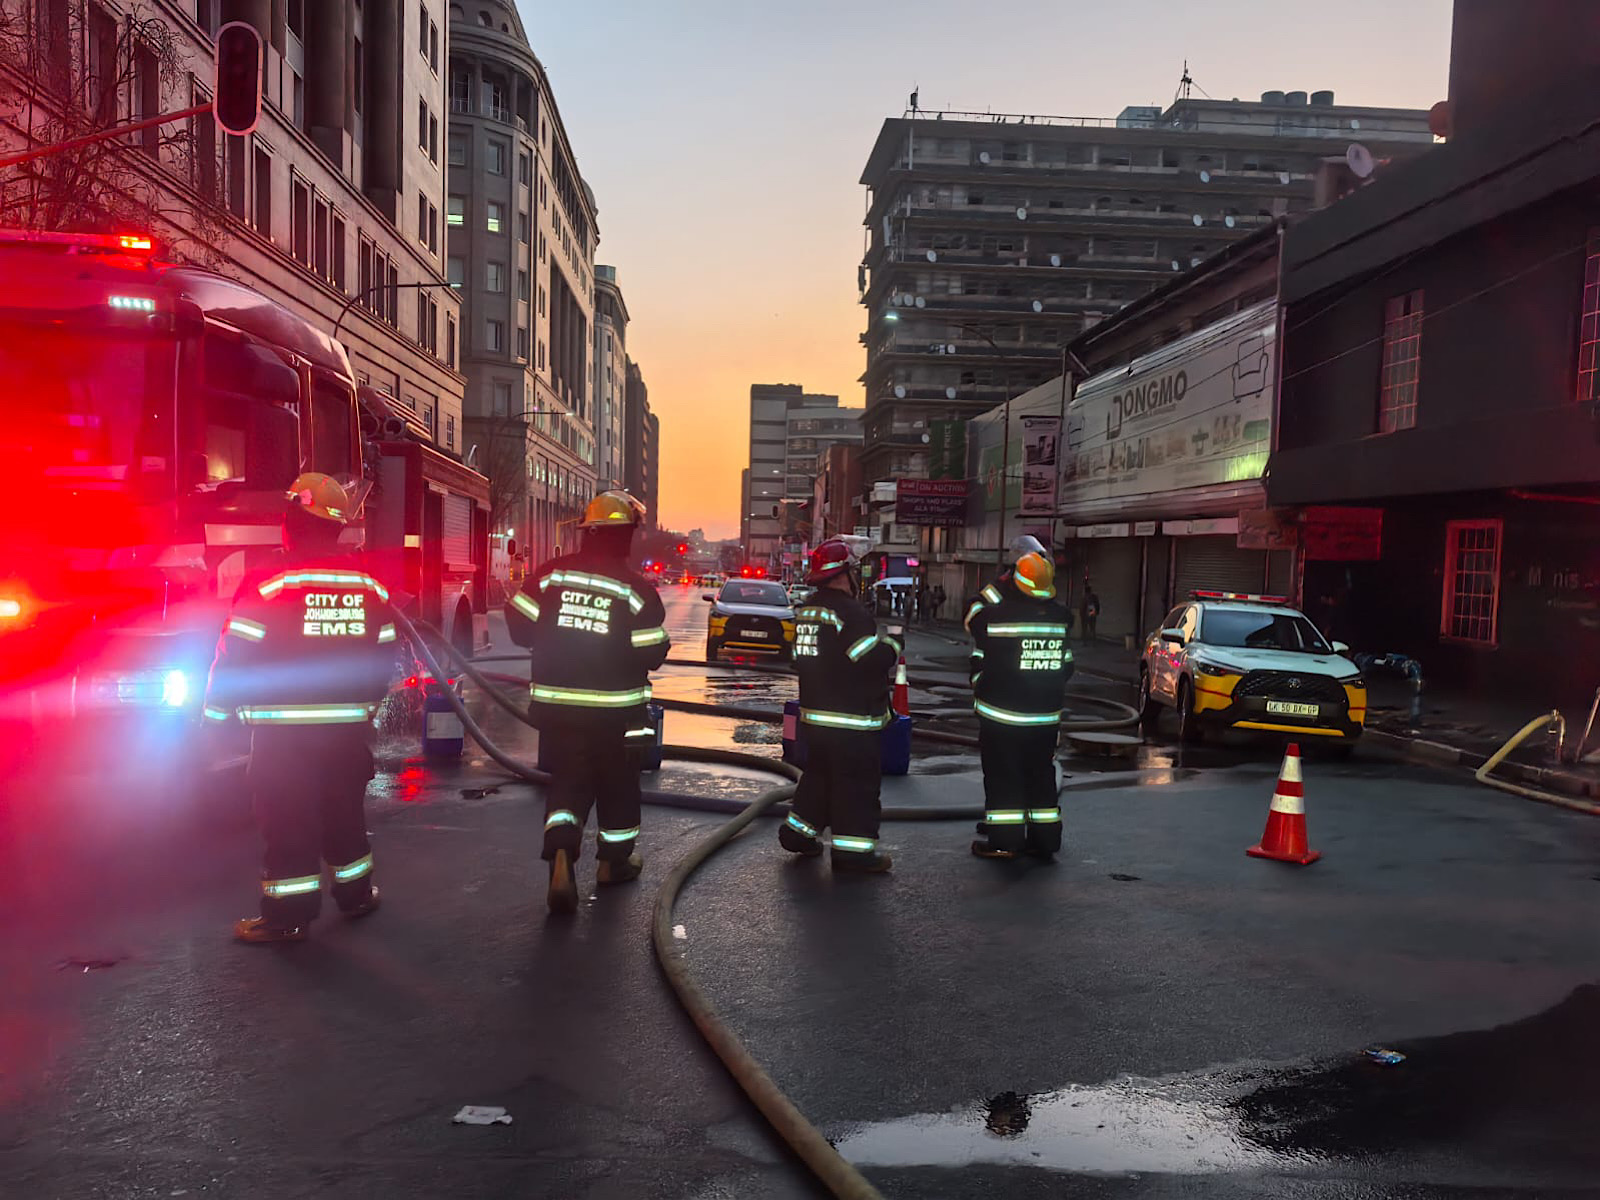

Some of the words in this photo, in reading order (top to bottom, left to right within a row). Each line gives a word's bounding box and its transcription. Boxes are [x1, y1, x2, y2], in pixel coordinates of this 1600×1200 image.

[1106, 370, 1188, 440] DONGMO
[304, 593, 338, 607] CITY
[342, 594, 364, 607] OF
[561, 591, 592, 604] CITY
[594, 597, 612, 609] OF
[303, 622, 366, 635] EMS
[557, 615, 609, 633] EMS
[1021, 639, 1046, 649] CITY
[1048, 640, 1063, 649] OF
[1020, 660, 1062, 670] EMS
